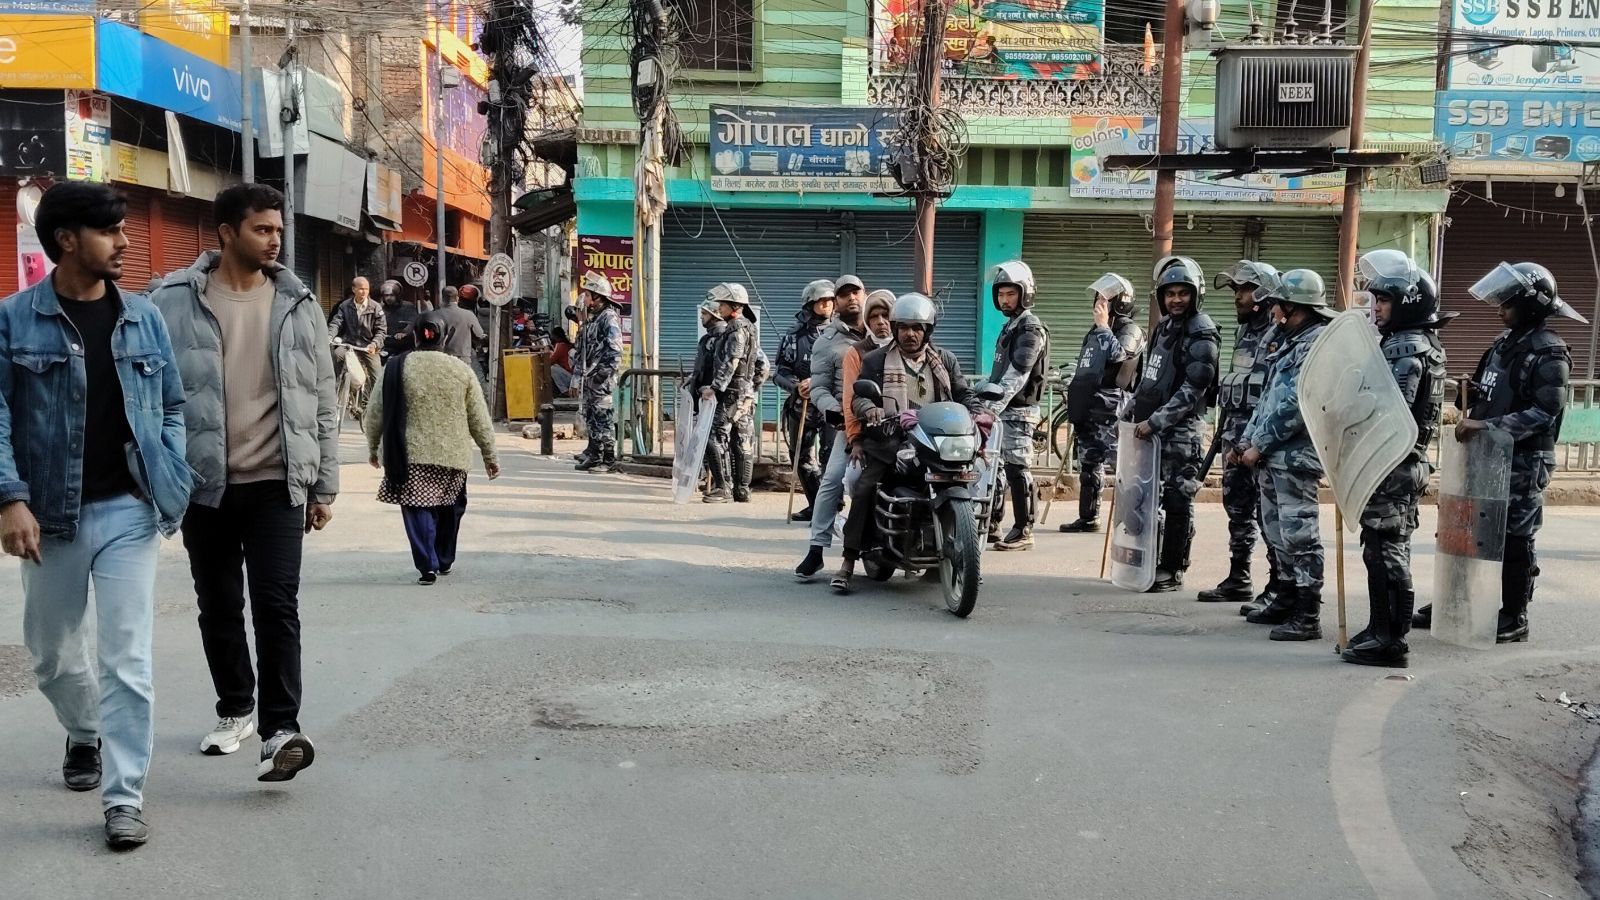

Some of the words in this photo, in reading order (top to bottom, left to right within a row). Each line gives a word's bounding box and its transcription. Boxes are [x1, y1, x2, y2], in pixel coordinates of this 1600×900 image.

[12, 1, 49, 10] Mobile
[1529, 27, 1555, 39] Laptop,
[1556, 28, 1587, 38] Printers,
[173, 65, 211, 102] vivo
[1516, 75, 1550, 84] lenovo
[1552, 75, 1582, 84] ASUS
[1280, 87, 1312, 99] NEEK
[1448, 100, 1509, 126] SSB
[715, 108, 813, 147] गोपाल
[1074, 127, 1122, 149] colors
[610, 272, 632, 292] स्टो
[1402, 294, 1422, 304] APF
